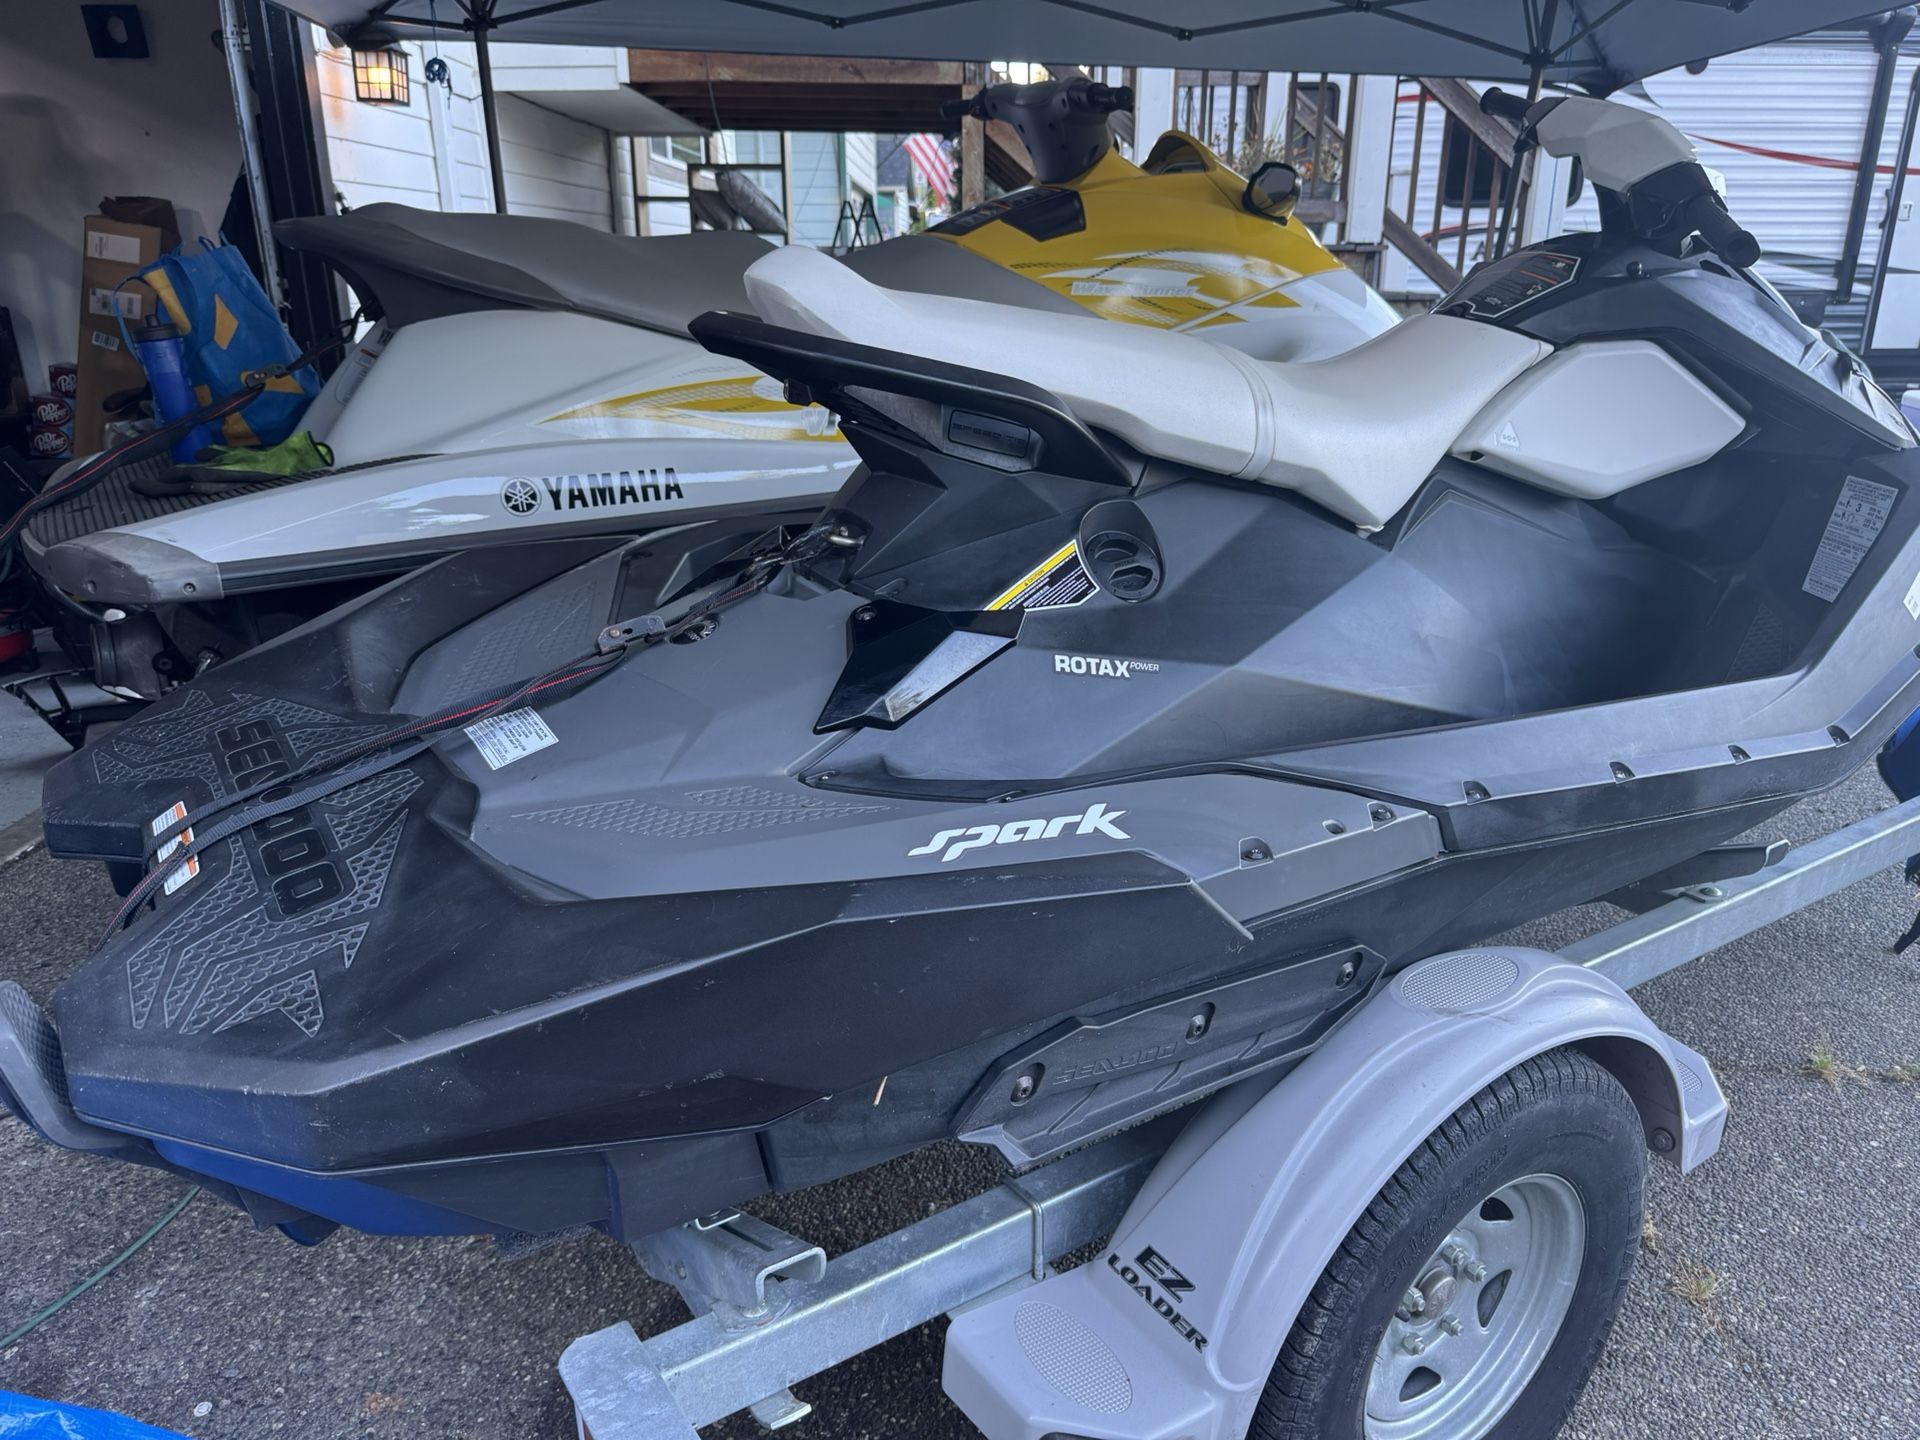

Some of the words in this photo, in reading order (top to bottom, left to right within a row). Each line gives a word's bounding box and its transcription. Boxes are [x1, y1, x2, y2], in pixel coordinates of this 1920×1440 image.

[37, 405, 67, 422] Pepper
[48, 403, 59, 413] Dr
[34, 435, 65, 451] Pepper
[44, 432, 56, 442] Dr
[541, 467, 684, 511] YAMAHA
[1054, 654, 1130, 678] ROTAX
[1129, 661, 1160, 672] POWER
[907, 802, 1131, 863] spark
[1134, 1244, 1196, 1304] EZ
[1107, 1252, 1208, 1354] LOADER
